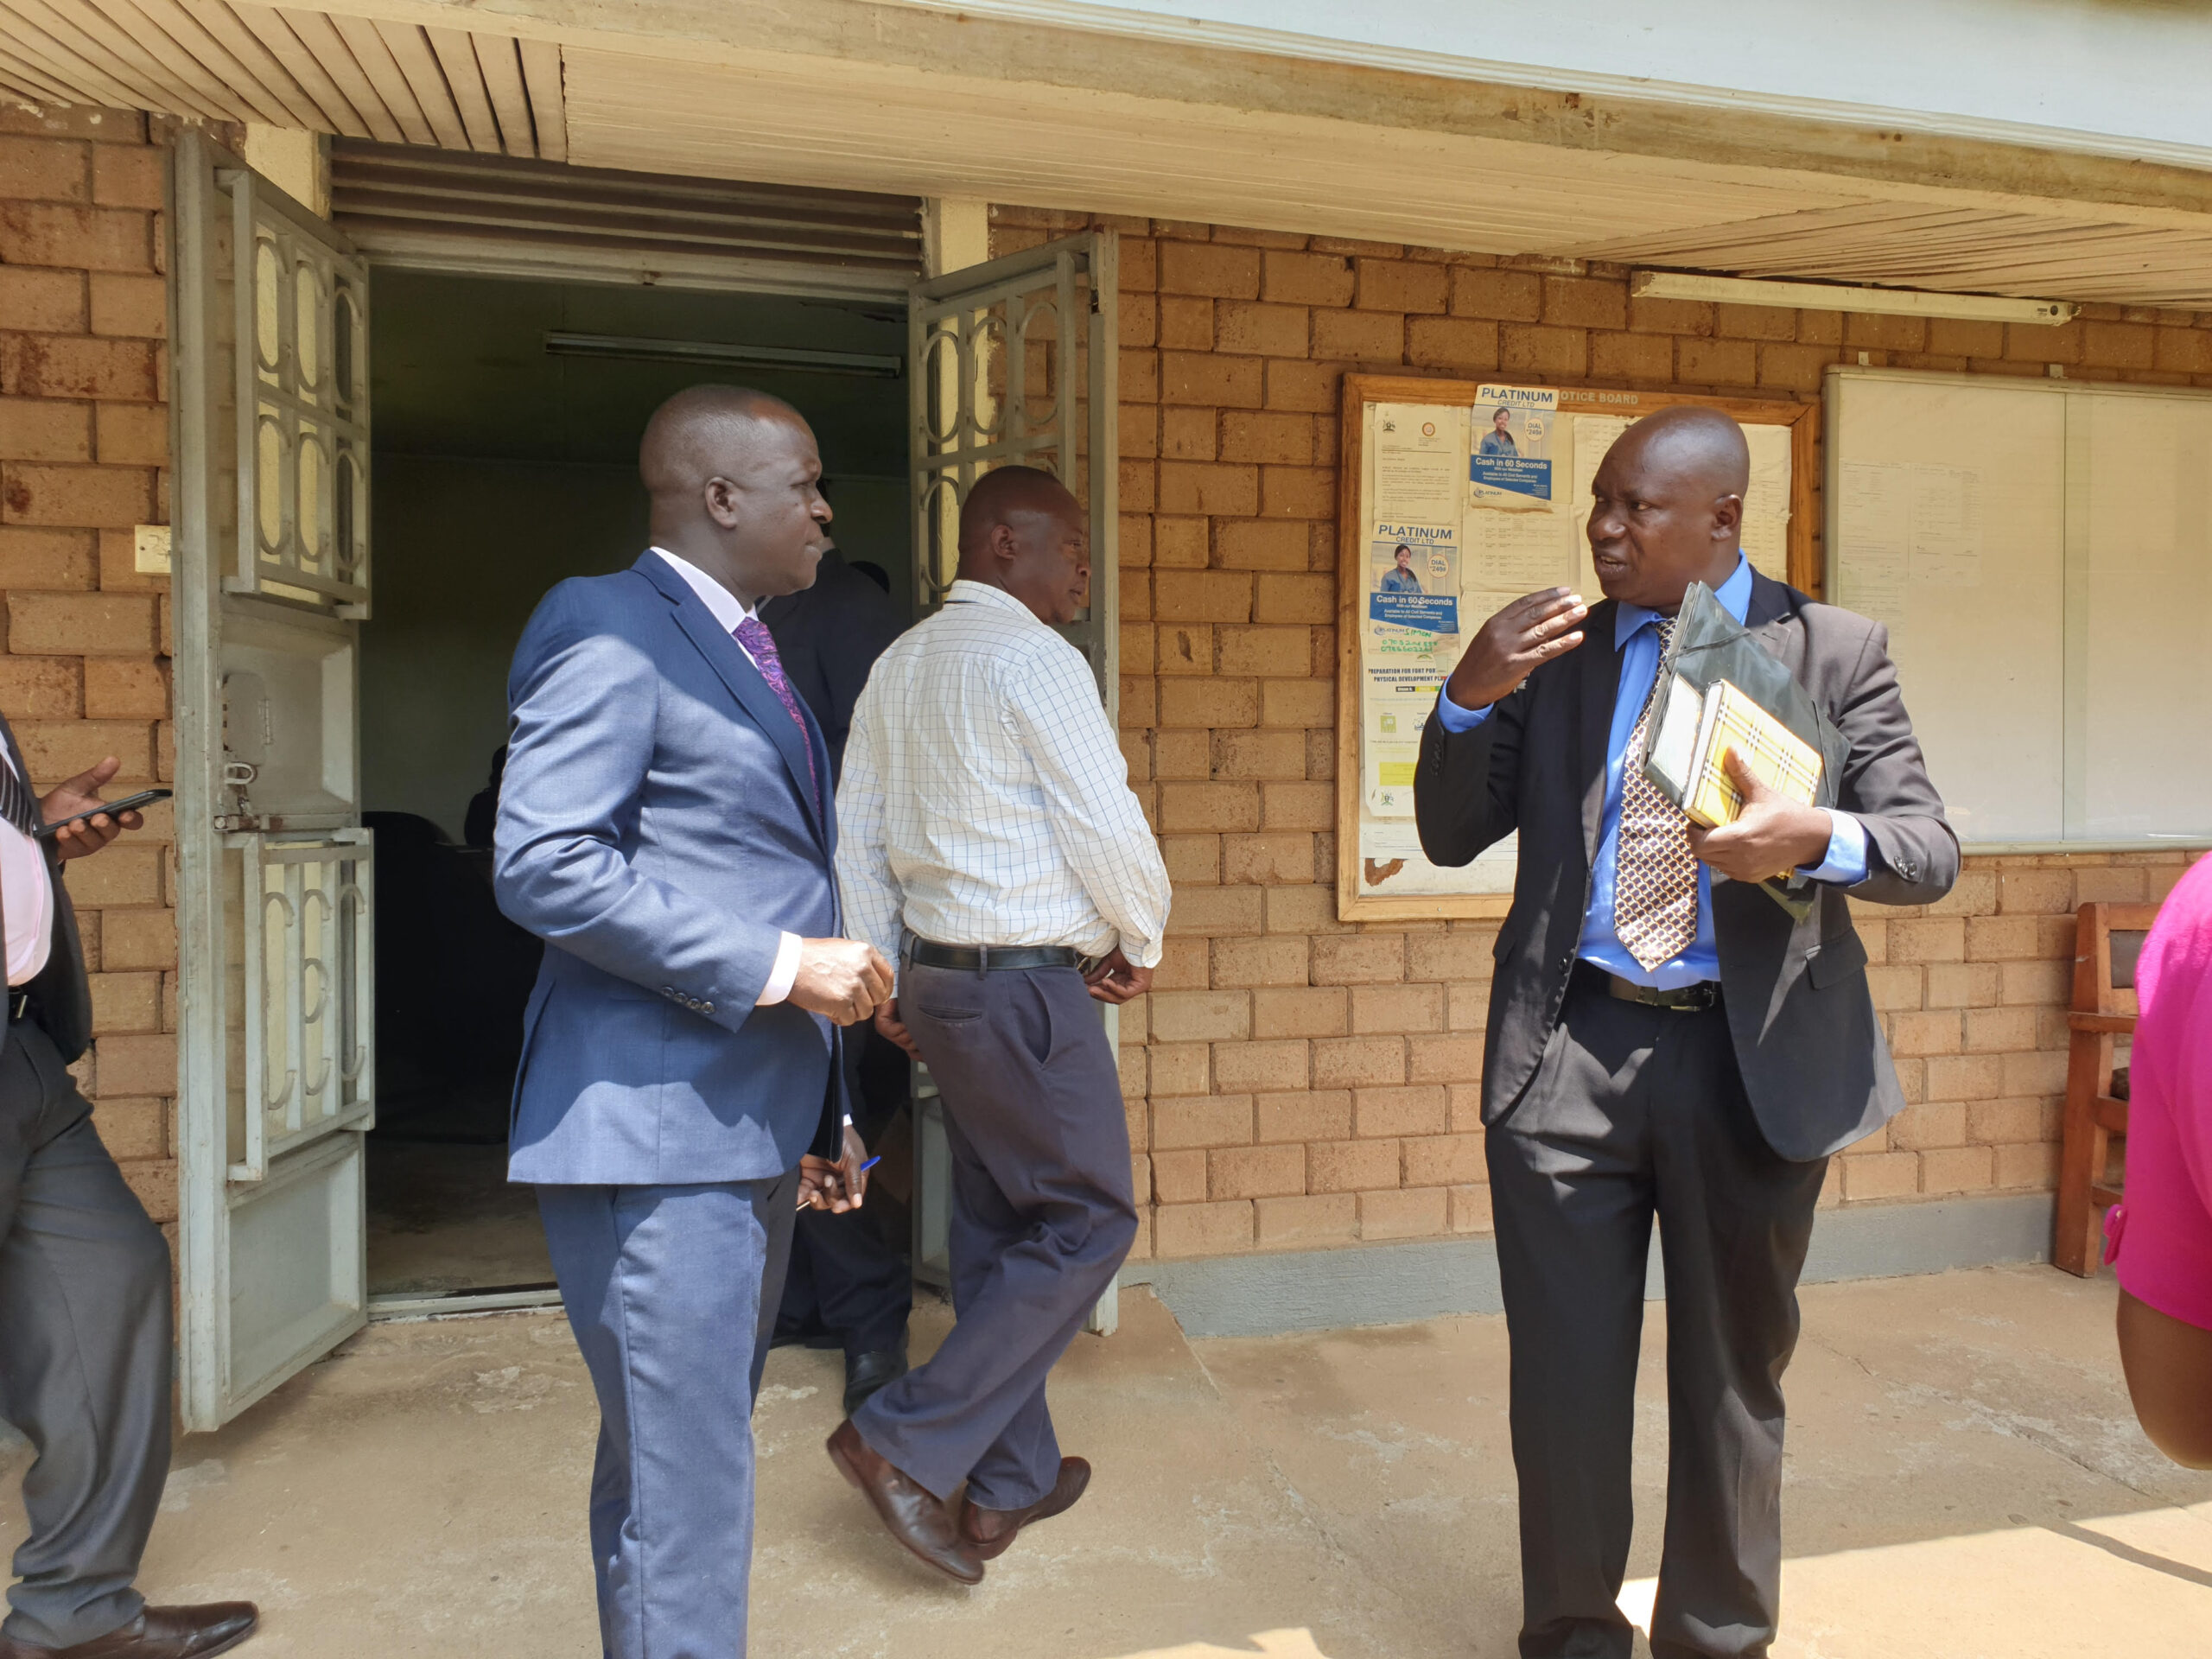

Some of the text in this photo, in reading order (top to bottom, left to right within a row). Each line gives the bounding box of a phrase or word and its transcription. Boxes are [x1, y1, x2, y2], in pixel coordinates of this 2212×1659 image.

[1482, 387, 1553, 403] PLATINUM
[1560, 391, 1638, 404] OTICE BOARD
[1475, 457, 1548, 470] Cash in 60 Seconds
[1378, 524, 1452, 539] PLATINUM
[1376, 594, 1397, 603] Cash
[1418, 596, 1453, 606] Seconds
